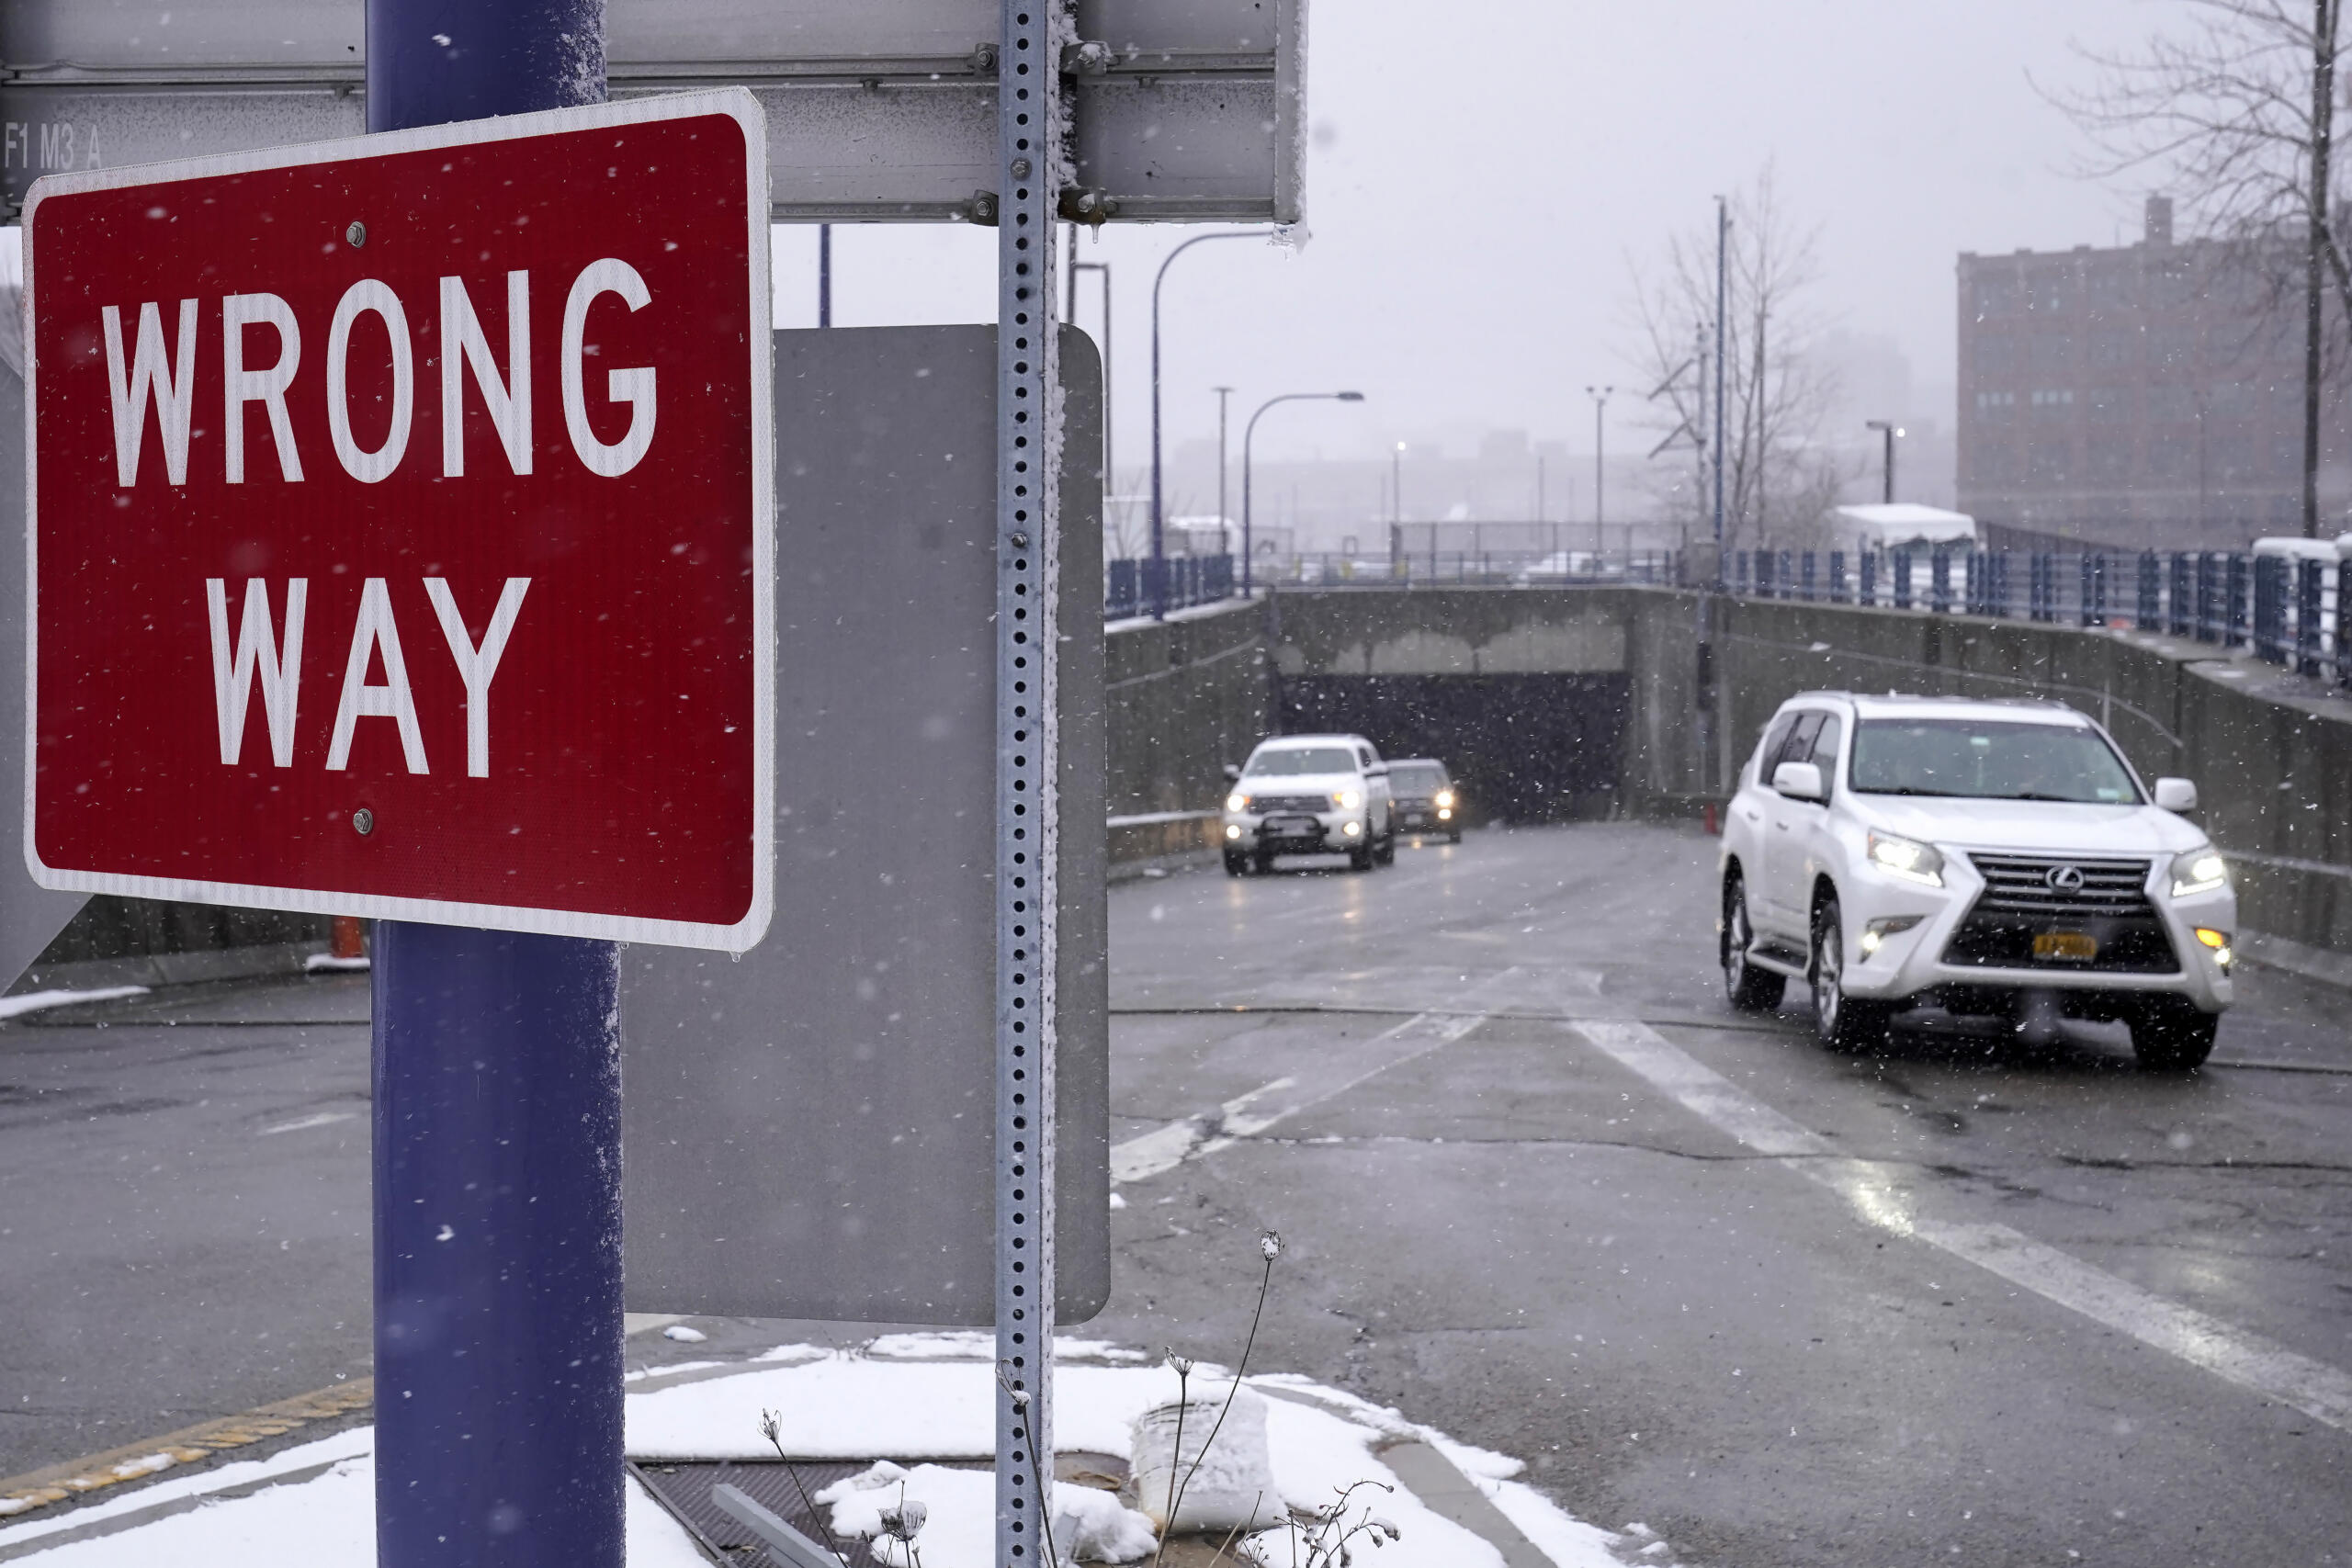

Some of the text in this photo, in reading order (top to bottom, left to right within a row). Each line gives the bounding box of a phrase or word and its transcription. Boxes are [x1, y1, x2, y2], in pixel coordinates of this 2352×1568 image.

[40, 122, 74, 170] M3
[87, 123, 102, 169] A
[102, 257, 658, 488] WRONG
[206, 576, 532, 779] WAY
